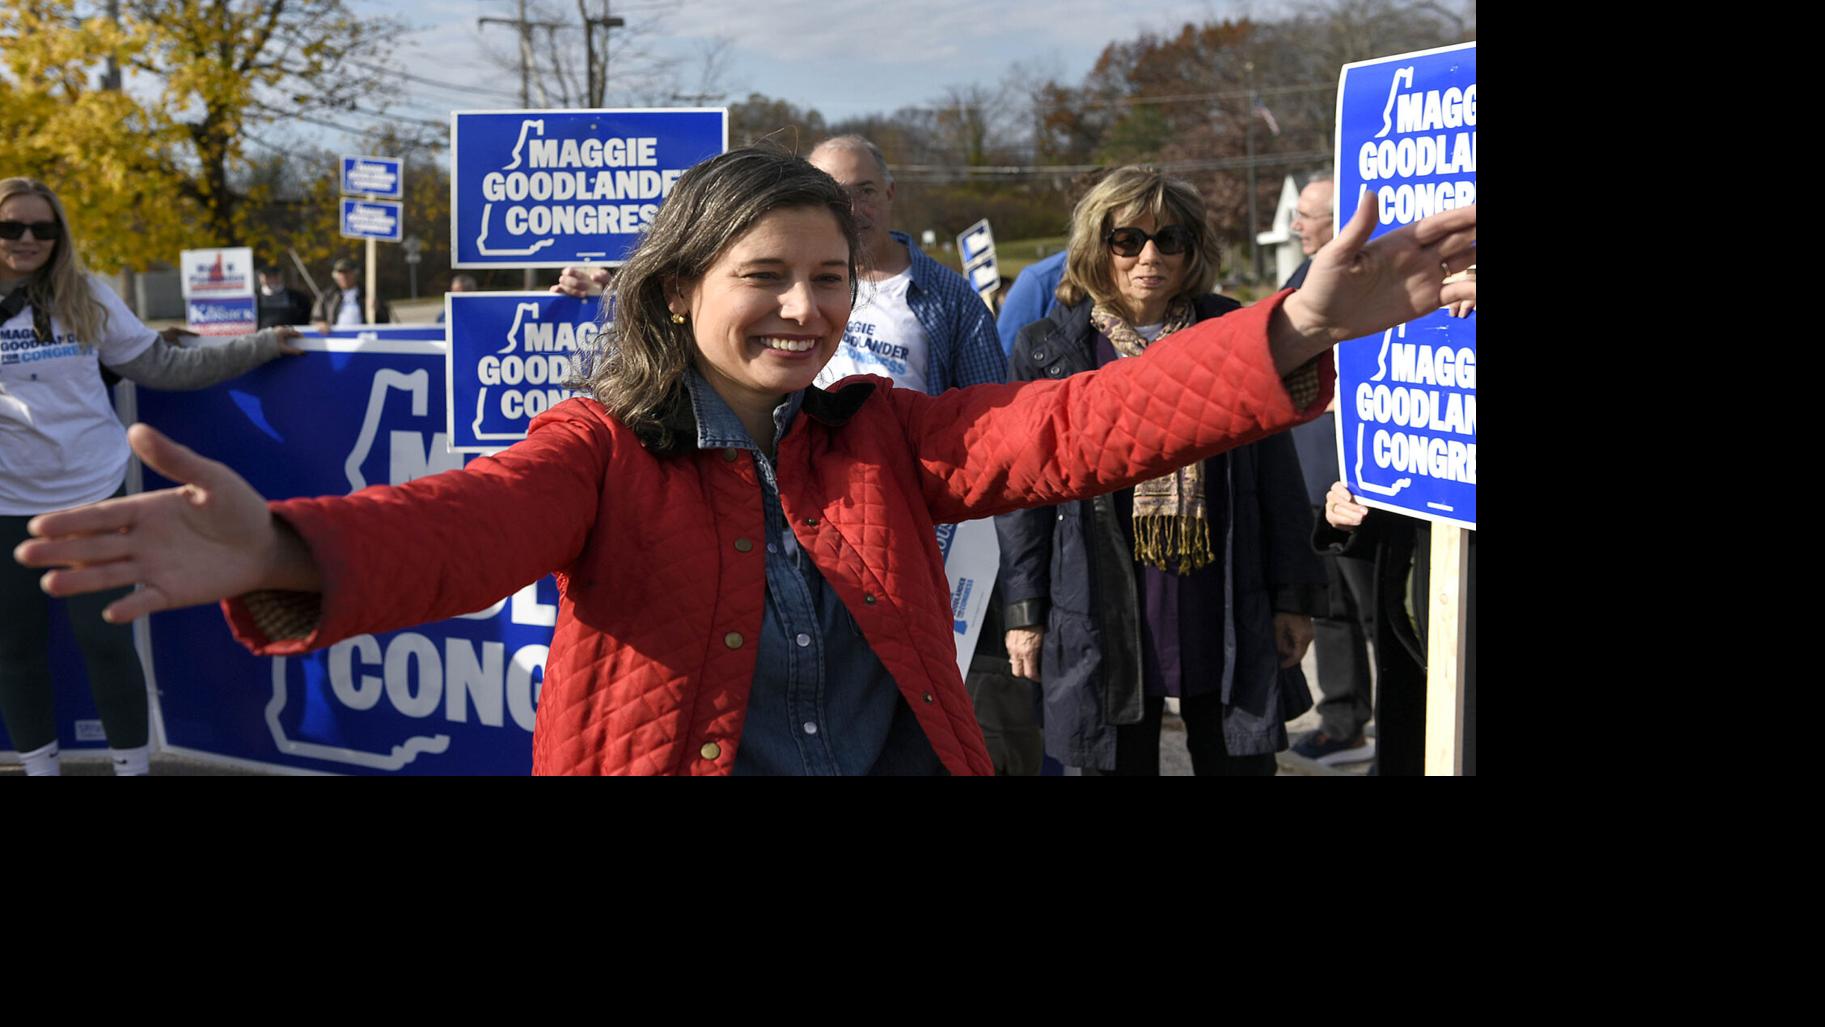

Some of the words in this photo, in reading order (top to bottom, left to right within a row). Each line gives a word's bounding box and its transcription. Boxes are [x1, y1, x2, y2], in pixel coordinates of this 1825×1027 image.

[529, 138, 657, 168] MAGGIE
[1359, 131, 1476, 181] GOODLA
[1378, 181, 1476, 225] CONGR
[0, 328, 36, 340] MAG
[328, 632, 550, 733] CONG
